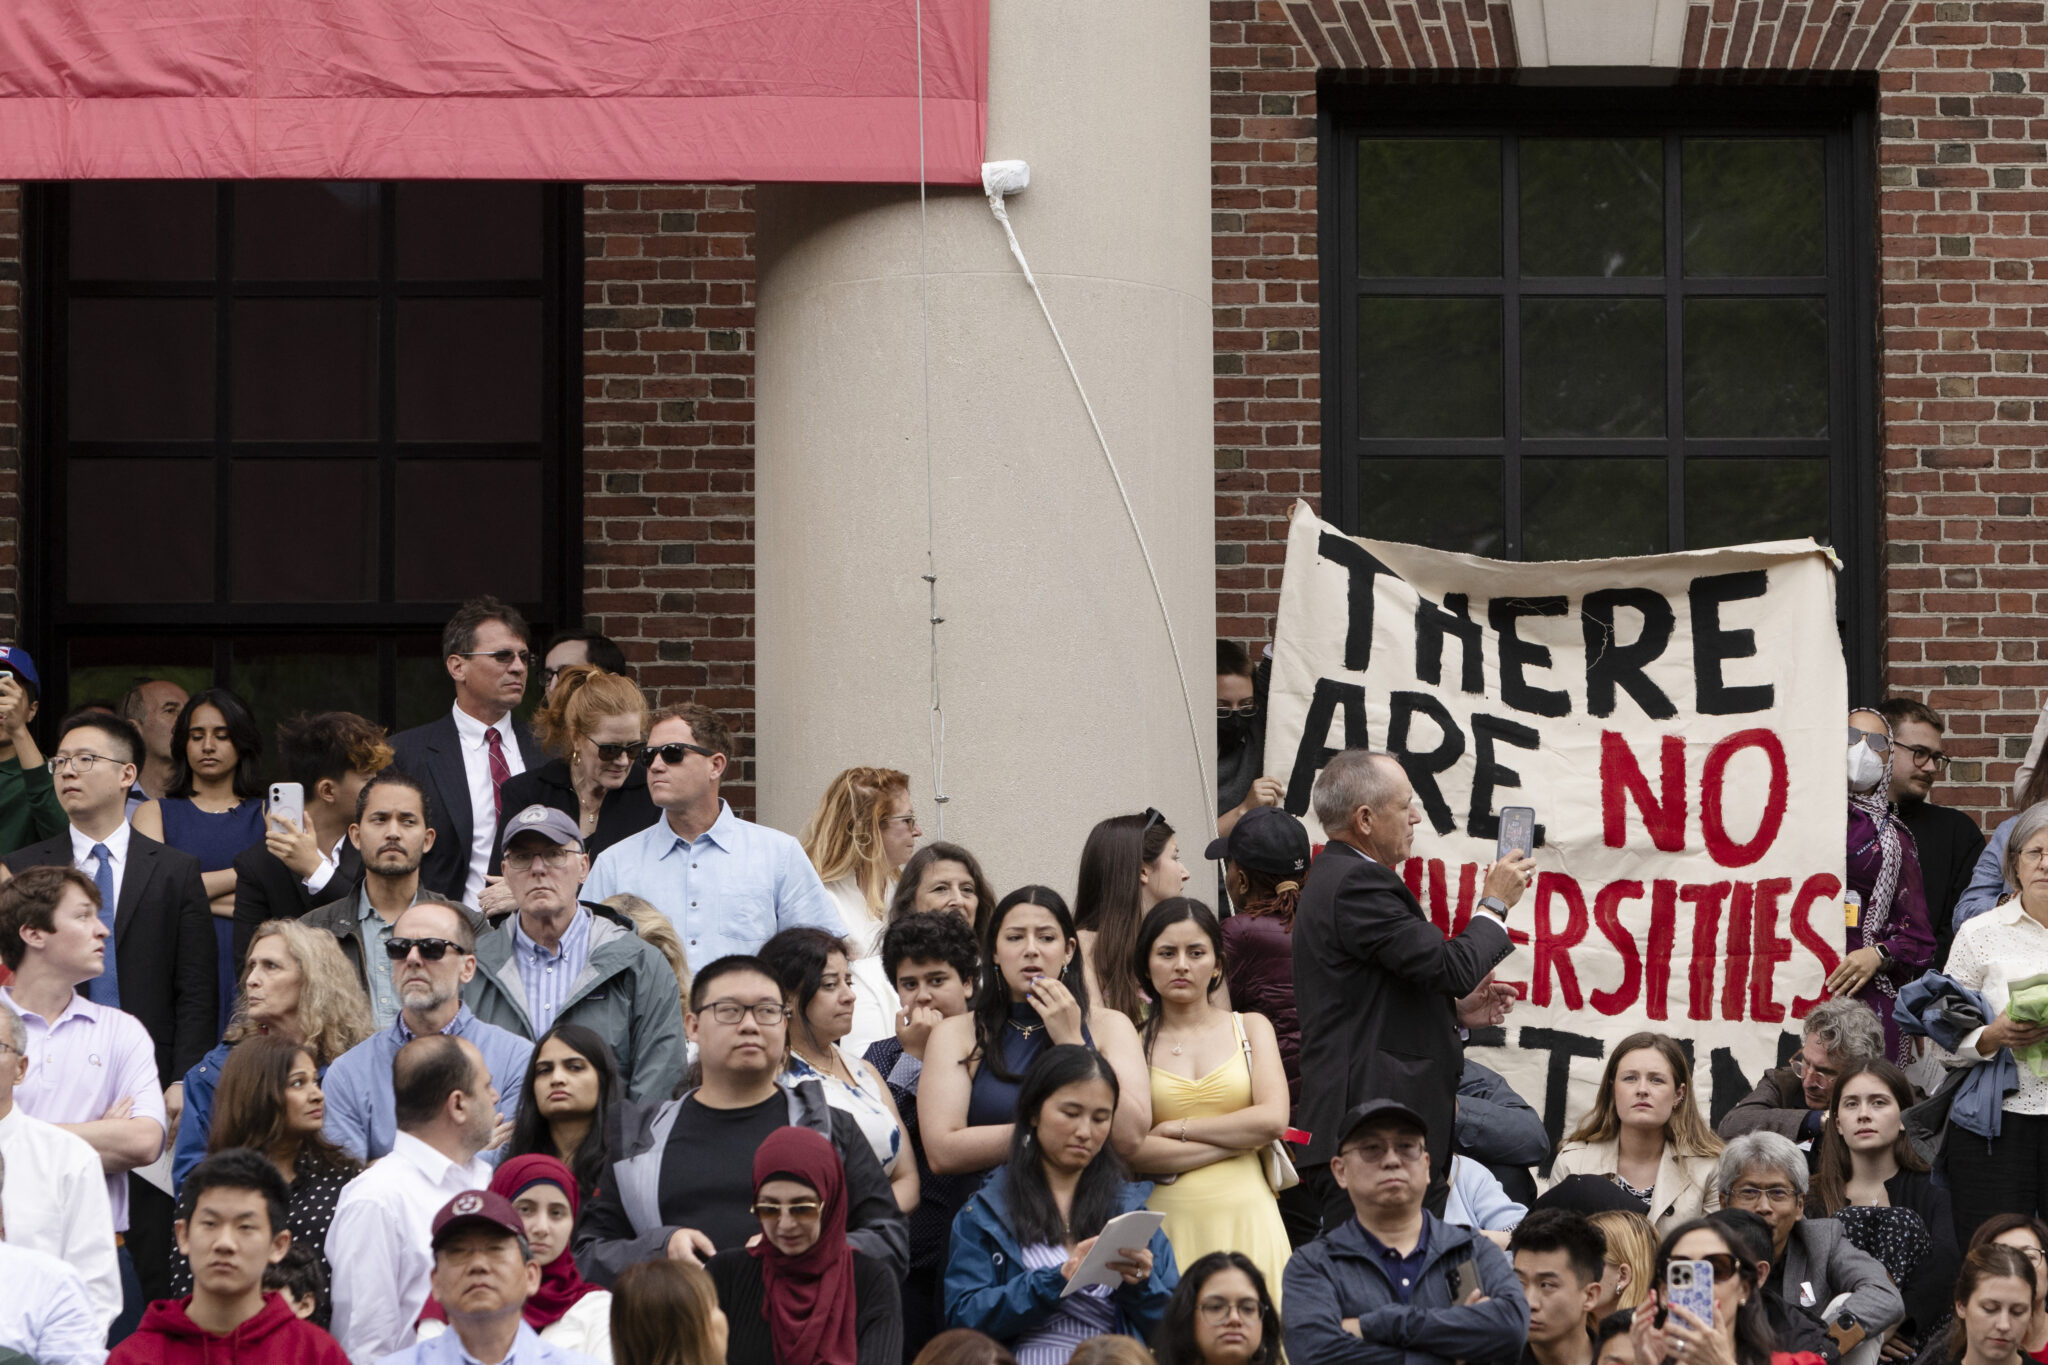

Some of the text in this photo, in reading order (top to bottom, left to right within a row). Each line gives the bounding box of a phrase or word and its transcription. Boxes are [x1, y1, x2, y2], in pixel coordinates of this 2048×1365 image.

[1318, 529, 1774, 720] THERE
[1283, 677, 1789, 869] ARE NO
